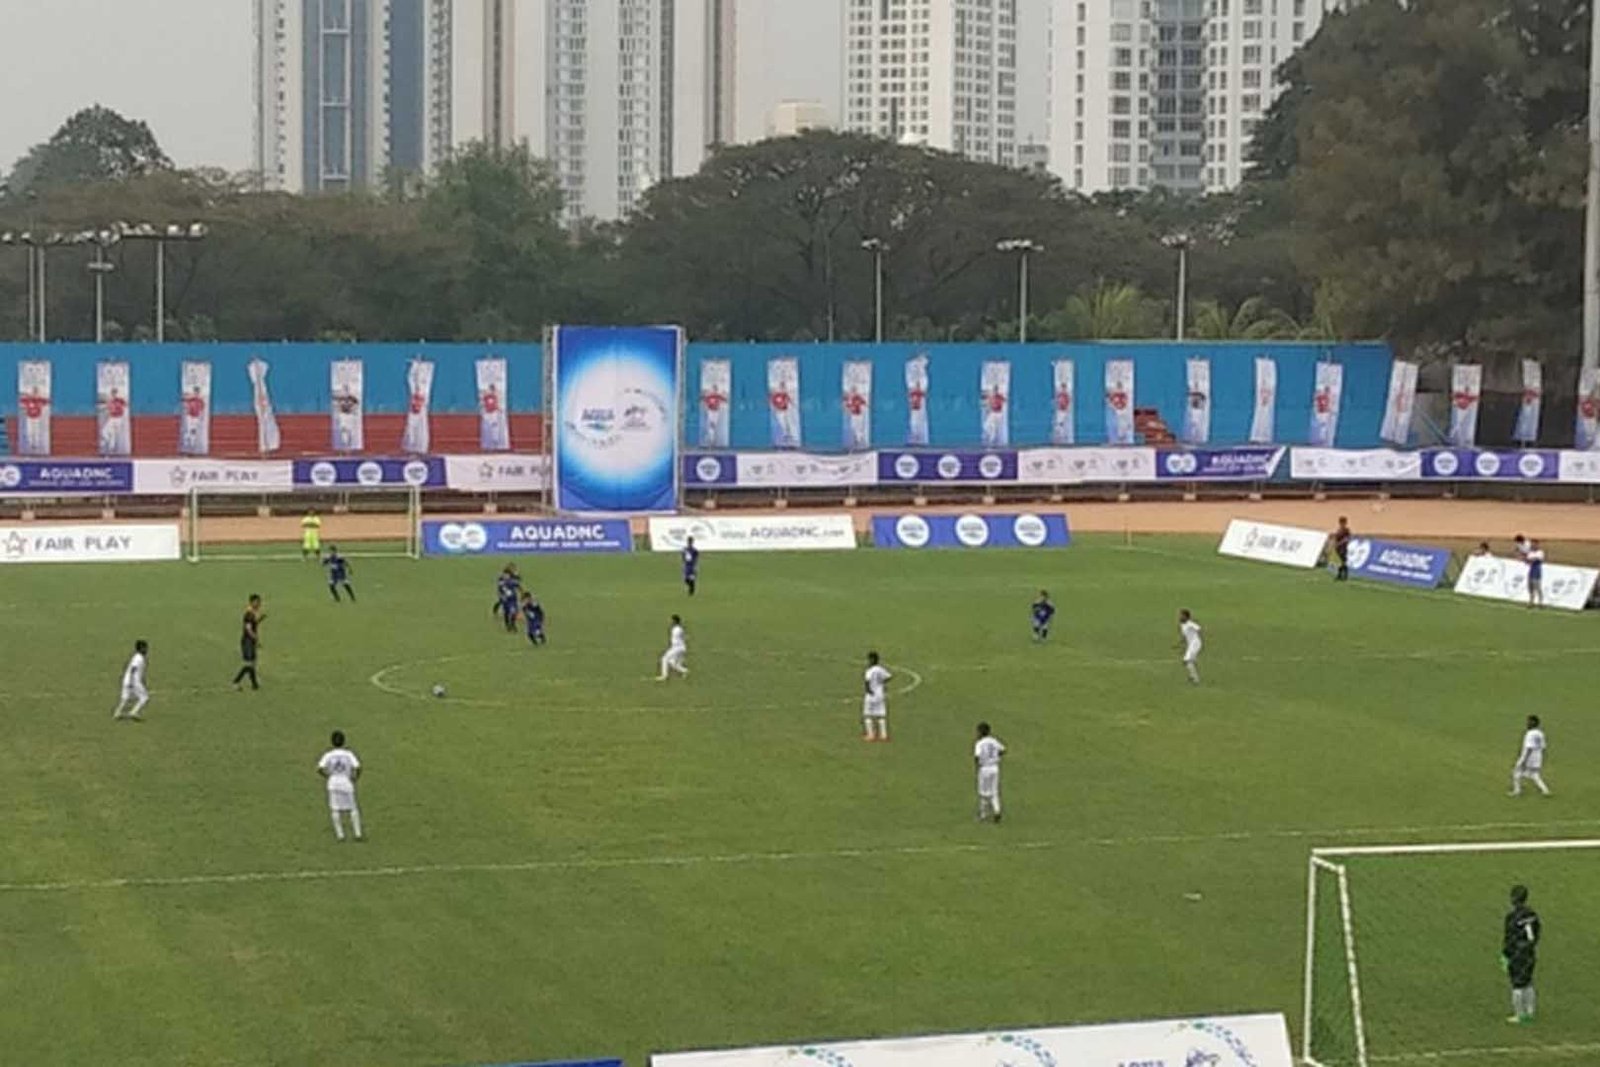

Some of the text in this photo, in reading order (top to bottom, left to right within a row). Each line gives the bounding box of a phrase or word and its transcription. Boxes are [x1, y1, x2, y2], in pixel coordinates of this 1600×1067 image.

[510, 524, 606, 540] AQUADNC
[34, 536, 131, 551] FAIR PLAY
